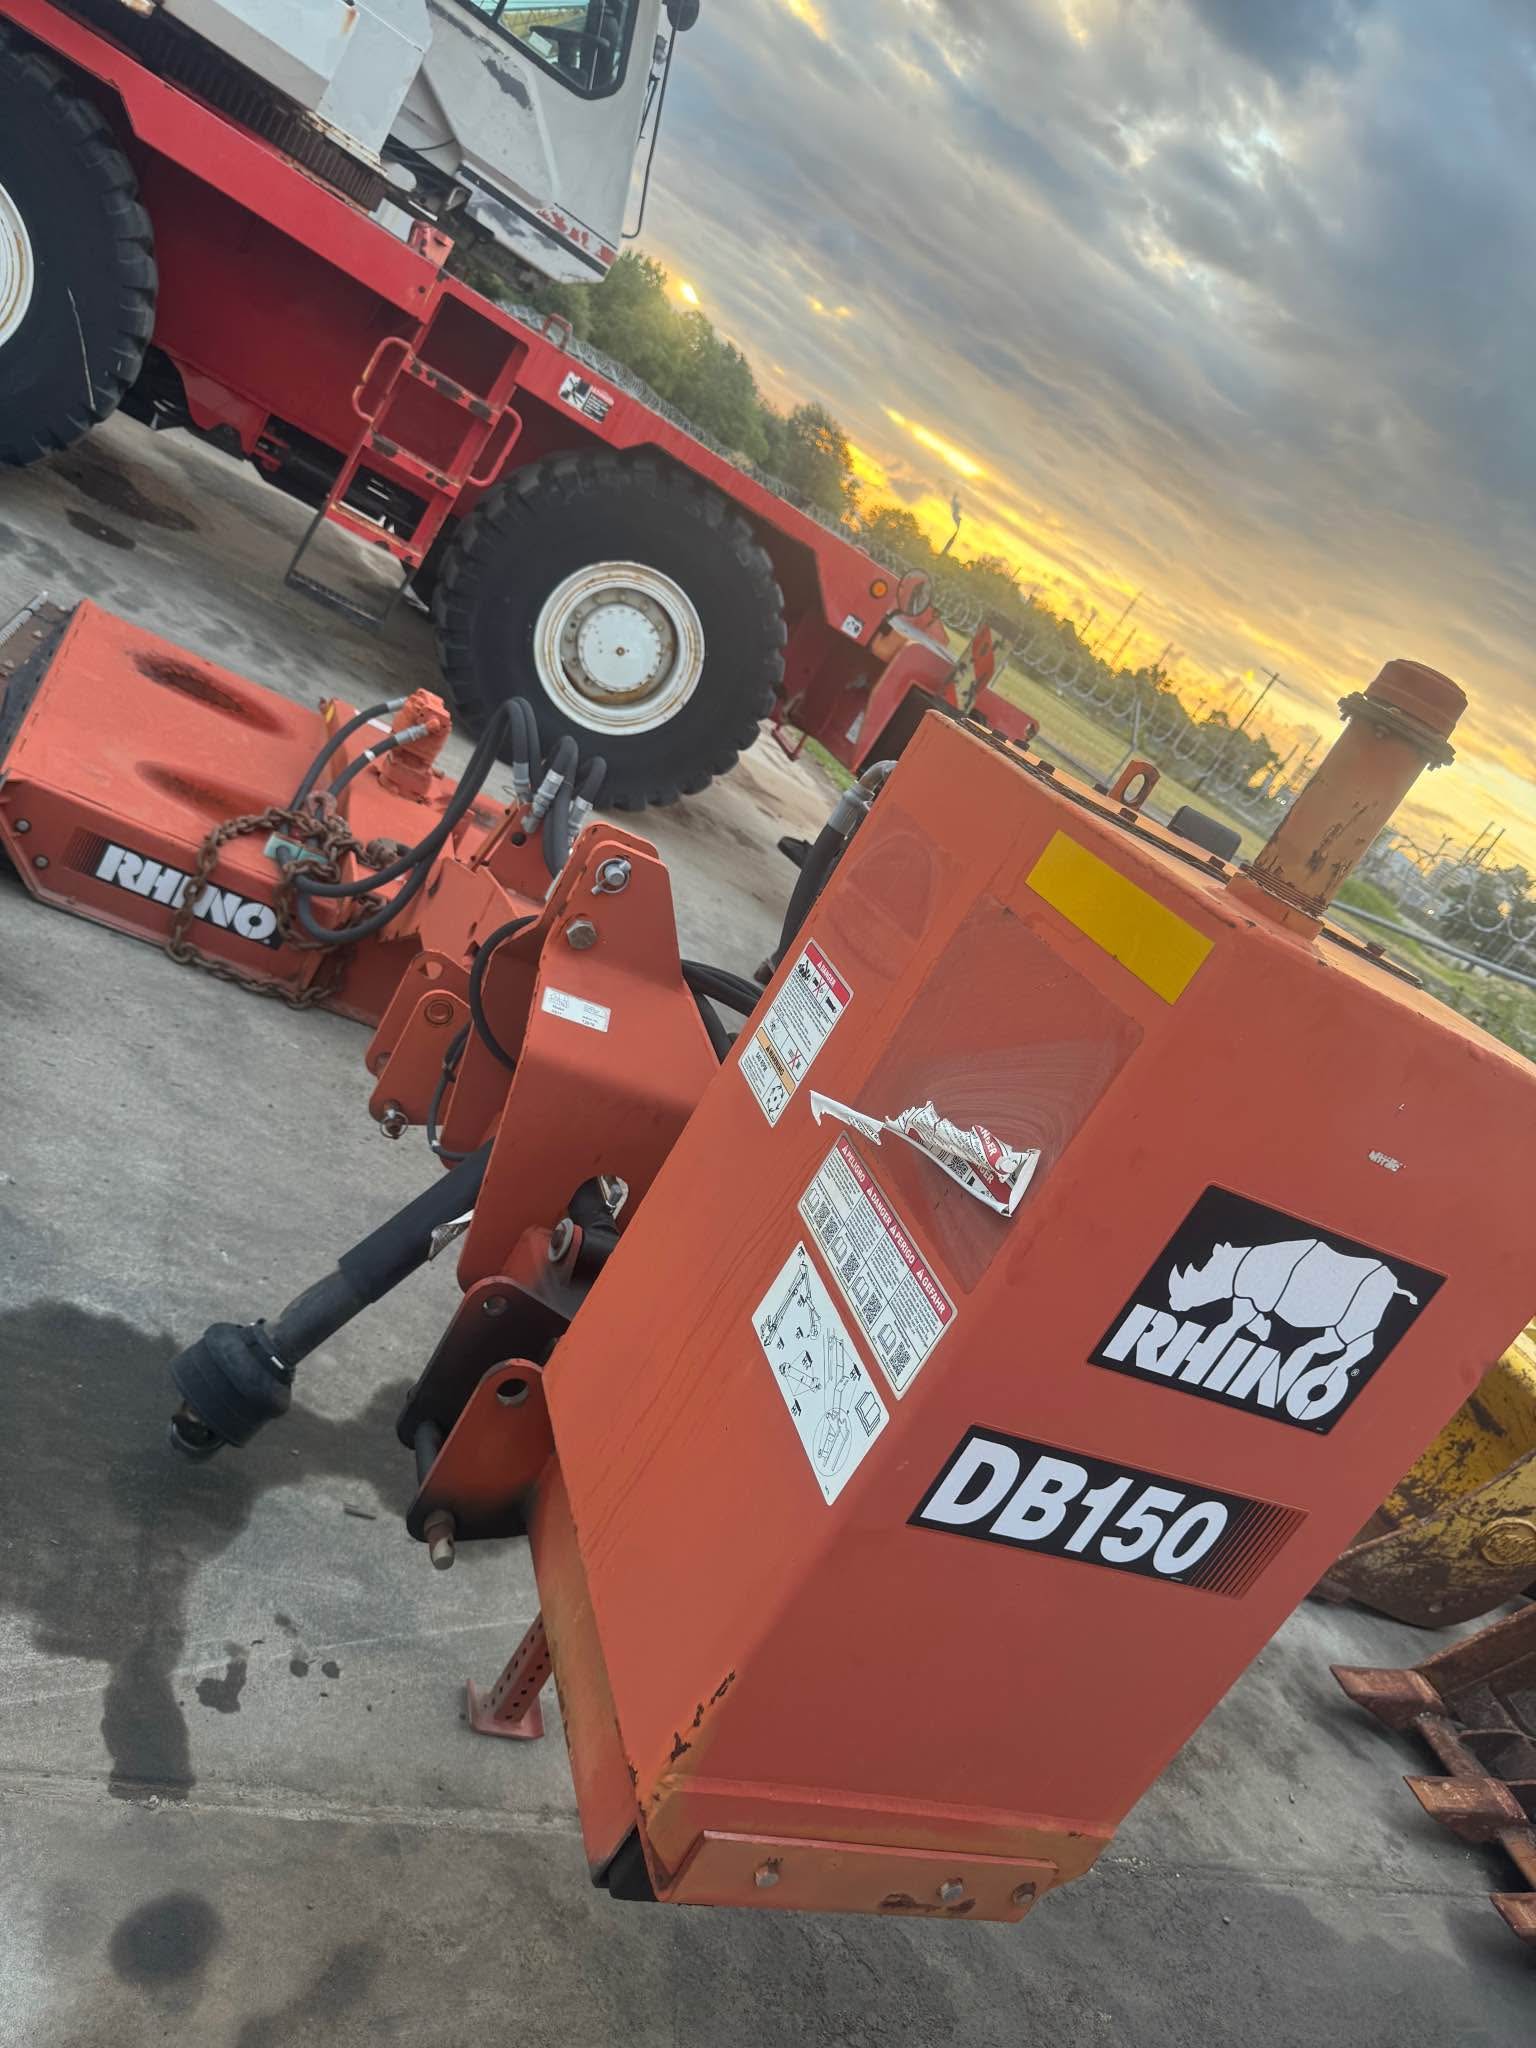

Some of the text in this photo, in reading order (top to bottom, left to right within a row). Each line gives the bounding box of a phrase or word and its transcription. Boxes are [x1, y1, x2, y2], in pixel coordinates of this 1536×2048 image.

[820, 964, 836, 988] DANGER
[769, 1048, 785, 1077] WARNING
[979, 1127, 998, 1157] NGER
[845, 1148, 866, 1183] PELIGRO
[870, 1192, 892, 1227] DANGER
[894, 1229, 916, 1265] PERIGO
[921, 1276, 946, 1315] GEFAHR
[1102, 1303, 1349, 1420] RHINO
[919, 1436, 1229, 1574] DB150
